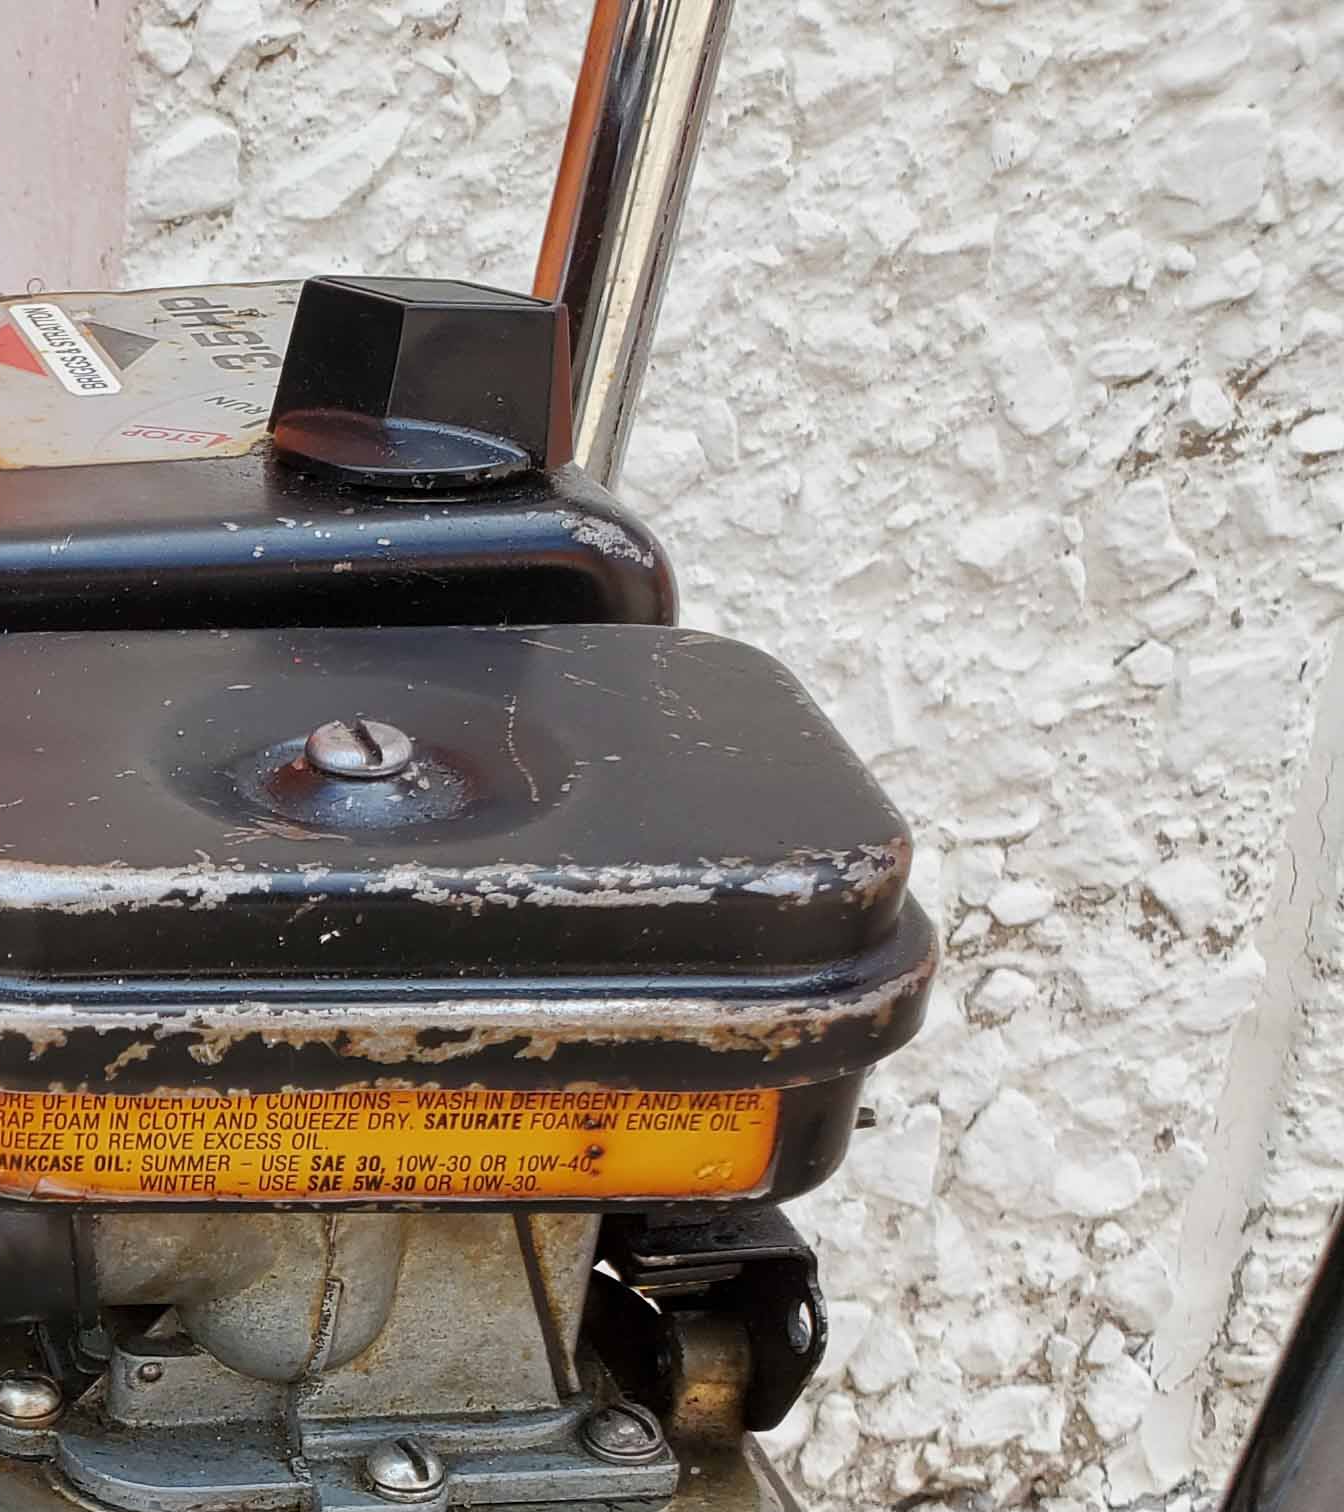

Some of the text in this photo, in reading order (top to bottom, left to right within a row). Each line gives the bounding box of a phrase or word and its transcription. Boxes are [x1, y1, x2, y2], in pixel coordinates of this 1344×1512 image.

[22, 307, 76, 347] STRATTON
[59, 355, 109, 390] BRIGGS
[203, 395, 269, 415] RUN
[121, 428, 205, 444] STOP
[265, 1092, 391, 1111] CONDITIONS
[416, 1091, 475, 1110] WASH
[484, 1091, 504, 1110] IN
[510, 1091, 633, 1111] DETERGENT
[637, 1092, 682, 1111] AND
[689, 1092, 765, 1111] WATER.
[41, 1112, 101, 1130] FOAM
[109, 1112, 130, 1130] IN
[138, 1112, 206, 1130] CLOTH
[214, 1112, 258, 1130] AND
[265, 1112, 360, 1131] SQUEEZE
[367, 1112, 415, 1130] DRY.
[423, 1112, 524, 1130] SATURATE
[529, 1112, 589, 1130] FOAM
[625, 1112, 705, 1131] ENGINE
[708, 1113, 742, 1131] OIL
[73, 1132, 99, 1150] TO
[108, 1132, 195, 1150] REMOVE
[203, 1132, 282, 1150] EXCESS
[291, 1132, 330, 1150] OIL.
[93, 1155, 133, 1172] OIL:
[140, 1154, 231, 1172] SUMMER
[261, 1154, 301, 1172] USE
[310, 1154, 347, 1172] SAE
[354, 1155, 387, 1175] 30,
[396, 1154, 472, 1172] 10W-30
[480, 1154, 507, 1172] OR
[139, 1174, 217, 1192] WINTER
[258, 1174, 298, 1192] USE
[306, 1174, 344, 1192] SAE
[352, 1174, 417, 1192] 5W-30
[423, 1174, 453, 1192] OR
